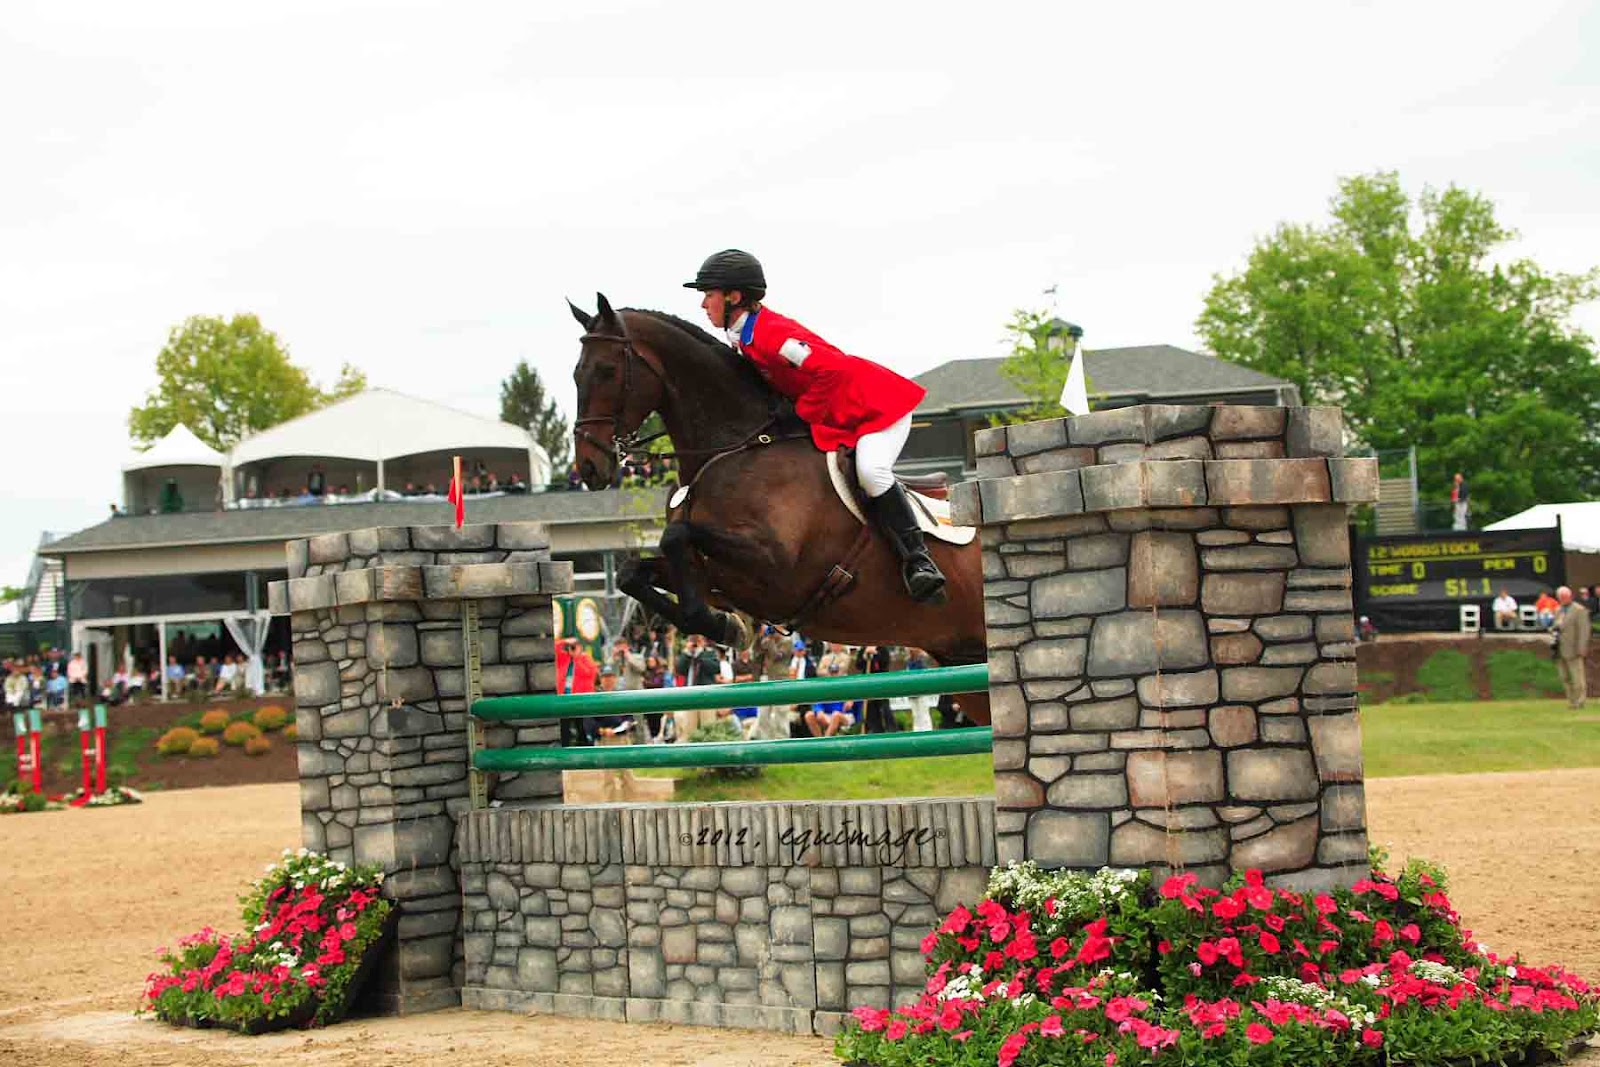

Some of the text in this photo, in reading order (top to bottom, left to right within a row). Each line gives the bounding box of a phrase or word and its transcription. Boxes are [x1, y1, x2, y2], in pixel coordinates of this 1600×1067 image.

[1368, 561, 1425, 579] TIME 0
[1533, 555, 1547, 574] 0
[1369, 583, 1418, 597] SCORE
